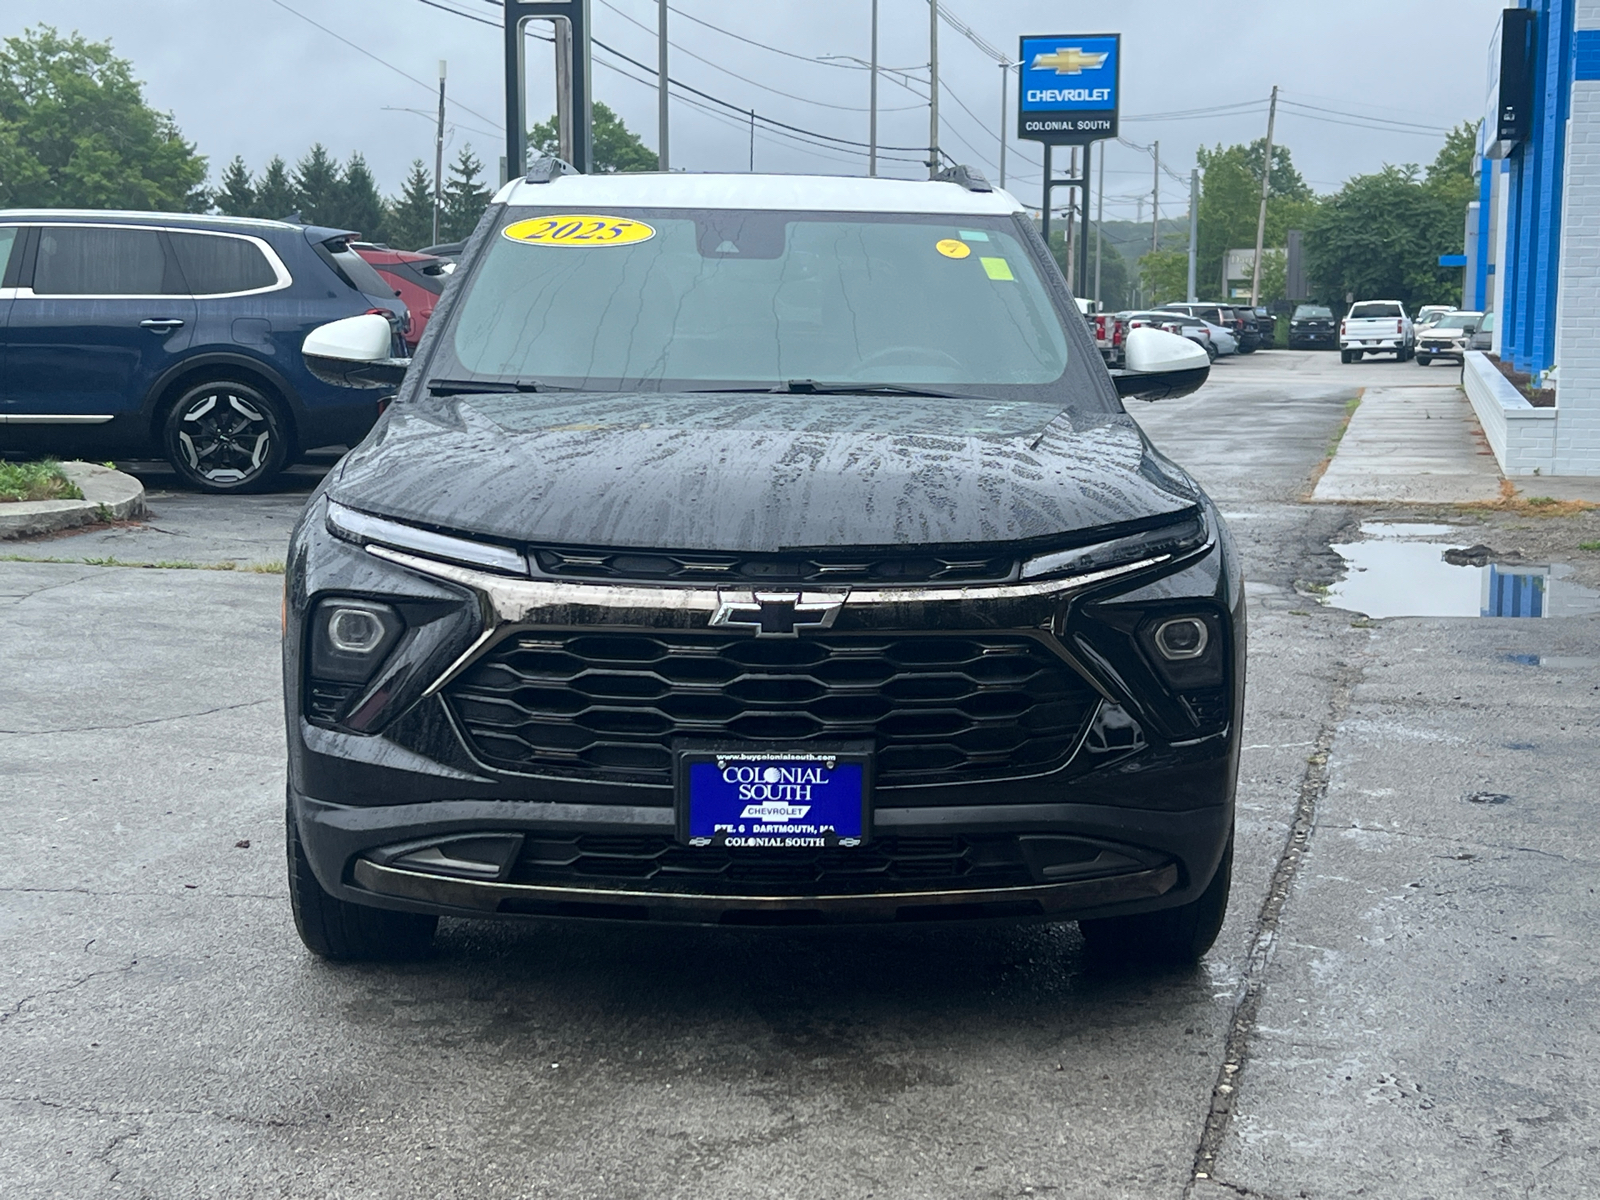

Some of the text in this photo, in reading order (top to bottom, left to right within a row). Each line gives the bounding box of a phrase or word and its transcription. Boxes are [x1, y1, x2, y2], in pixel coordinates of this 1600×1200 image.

[1027, 88, 1111, 102] CHEVROLET
[1025, 120, 1111, 131] COLONIAL SOUTH
[523, 221, 632, 240] 2025
[716, 753, 837, 762] www.buycolonialsouth.com
[723, 767, 829, 784] COLONIAL
[739, 784, 812, 800] SOUTH
[747, 807, 804, 816] CHEVROLET
[738, 824, 746, 833] 6
[753, 824, 818, 835] DARTMOUTH,
[725, 837, 825, 847] COLONIAL SOUTH
